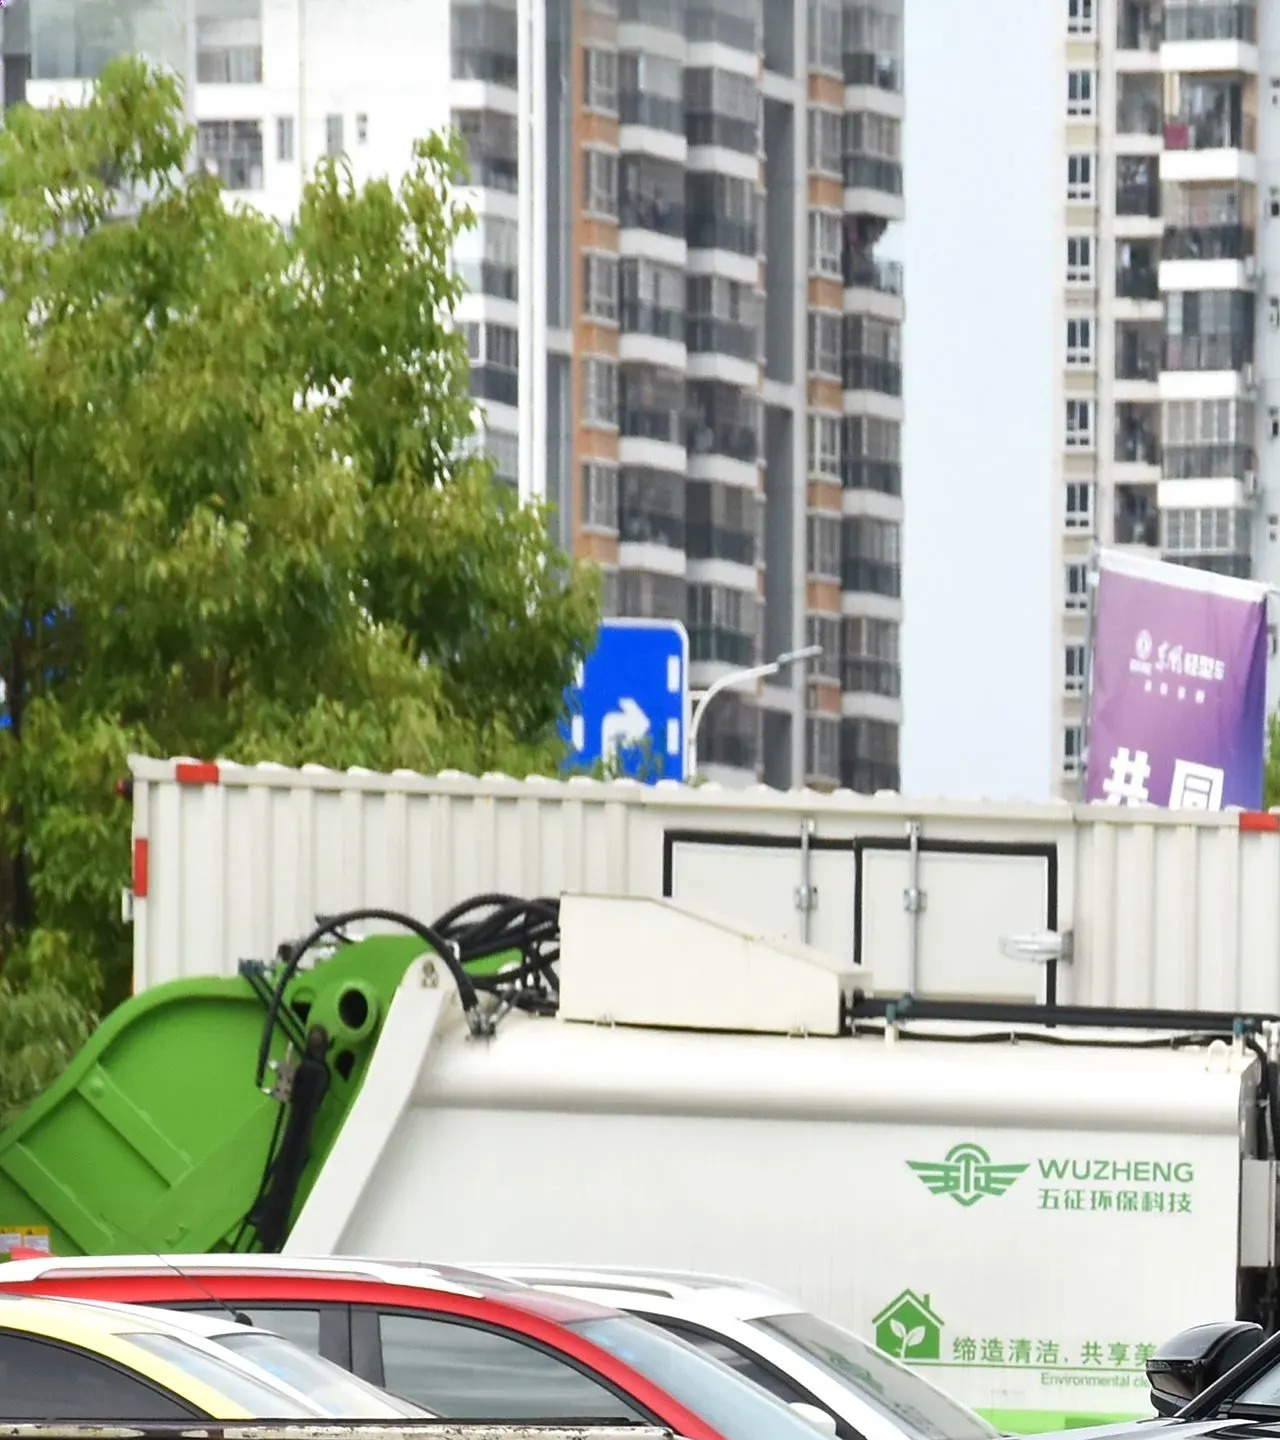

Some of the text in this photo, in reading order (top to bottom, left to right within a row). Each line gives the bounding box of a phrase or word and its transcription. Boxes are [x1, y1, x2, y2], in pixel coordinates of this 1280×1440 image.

[1038, 1158, 1194, 1183] WUZHENG
[1037, 1187, 1193, 1214] 五征环保科技
[1040, 1372, 1130, 1388] Environmental
